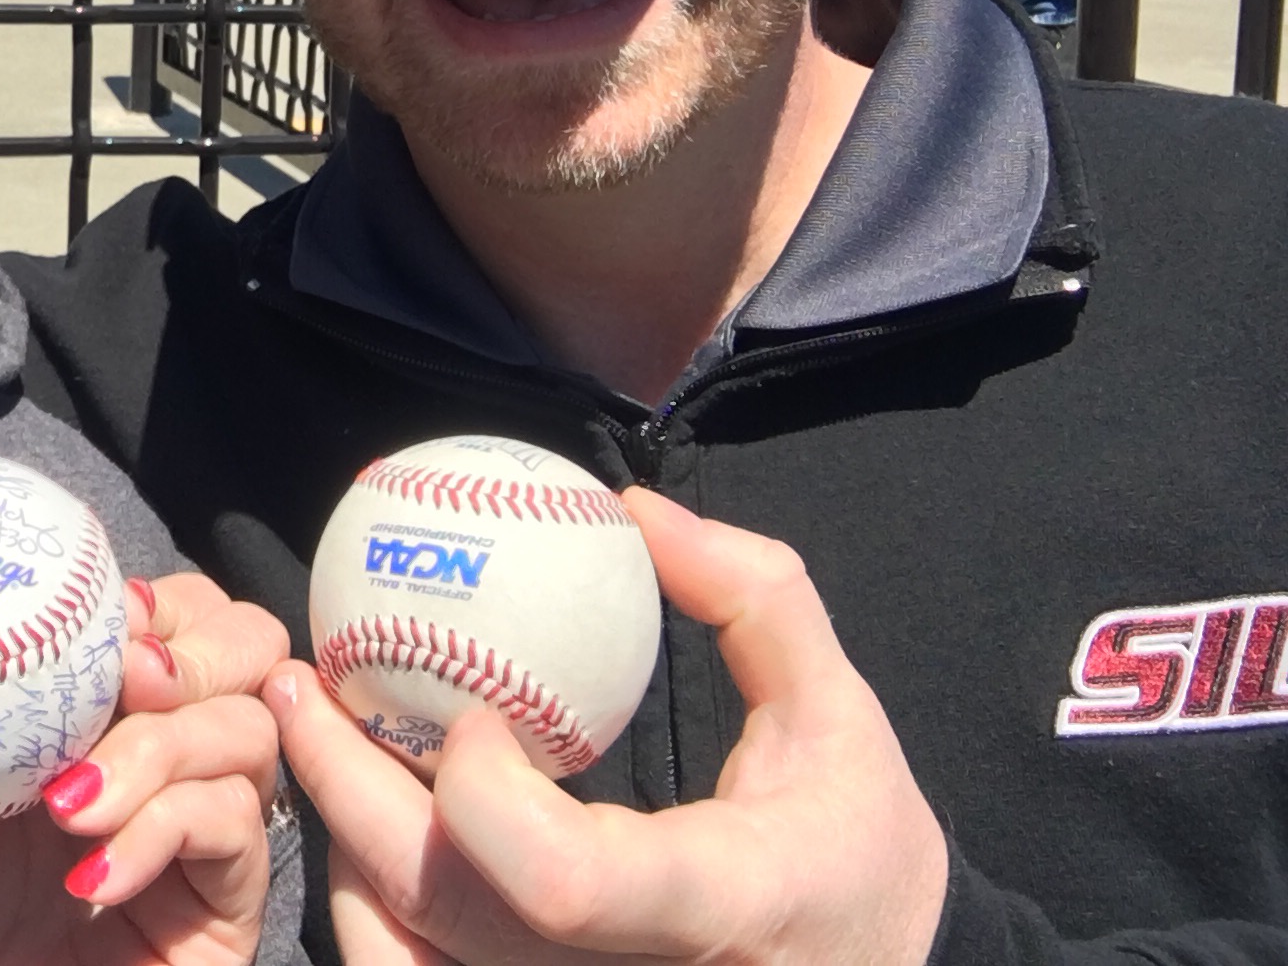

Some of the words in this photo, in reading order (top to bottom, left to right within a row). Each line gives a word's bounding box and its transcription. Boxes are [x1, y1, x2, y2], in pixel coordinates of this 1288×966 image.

[369, 522, 496, 549] CHAMPIONSHIP
[365, 536, 491, 589] NCAA
[368, 577, 400, 591] BALL
[405, 583, 474, 602] OFFICIAL
